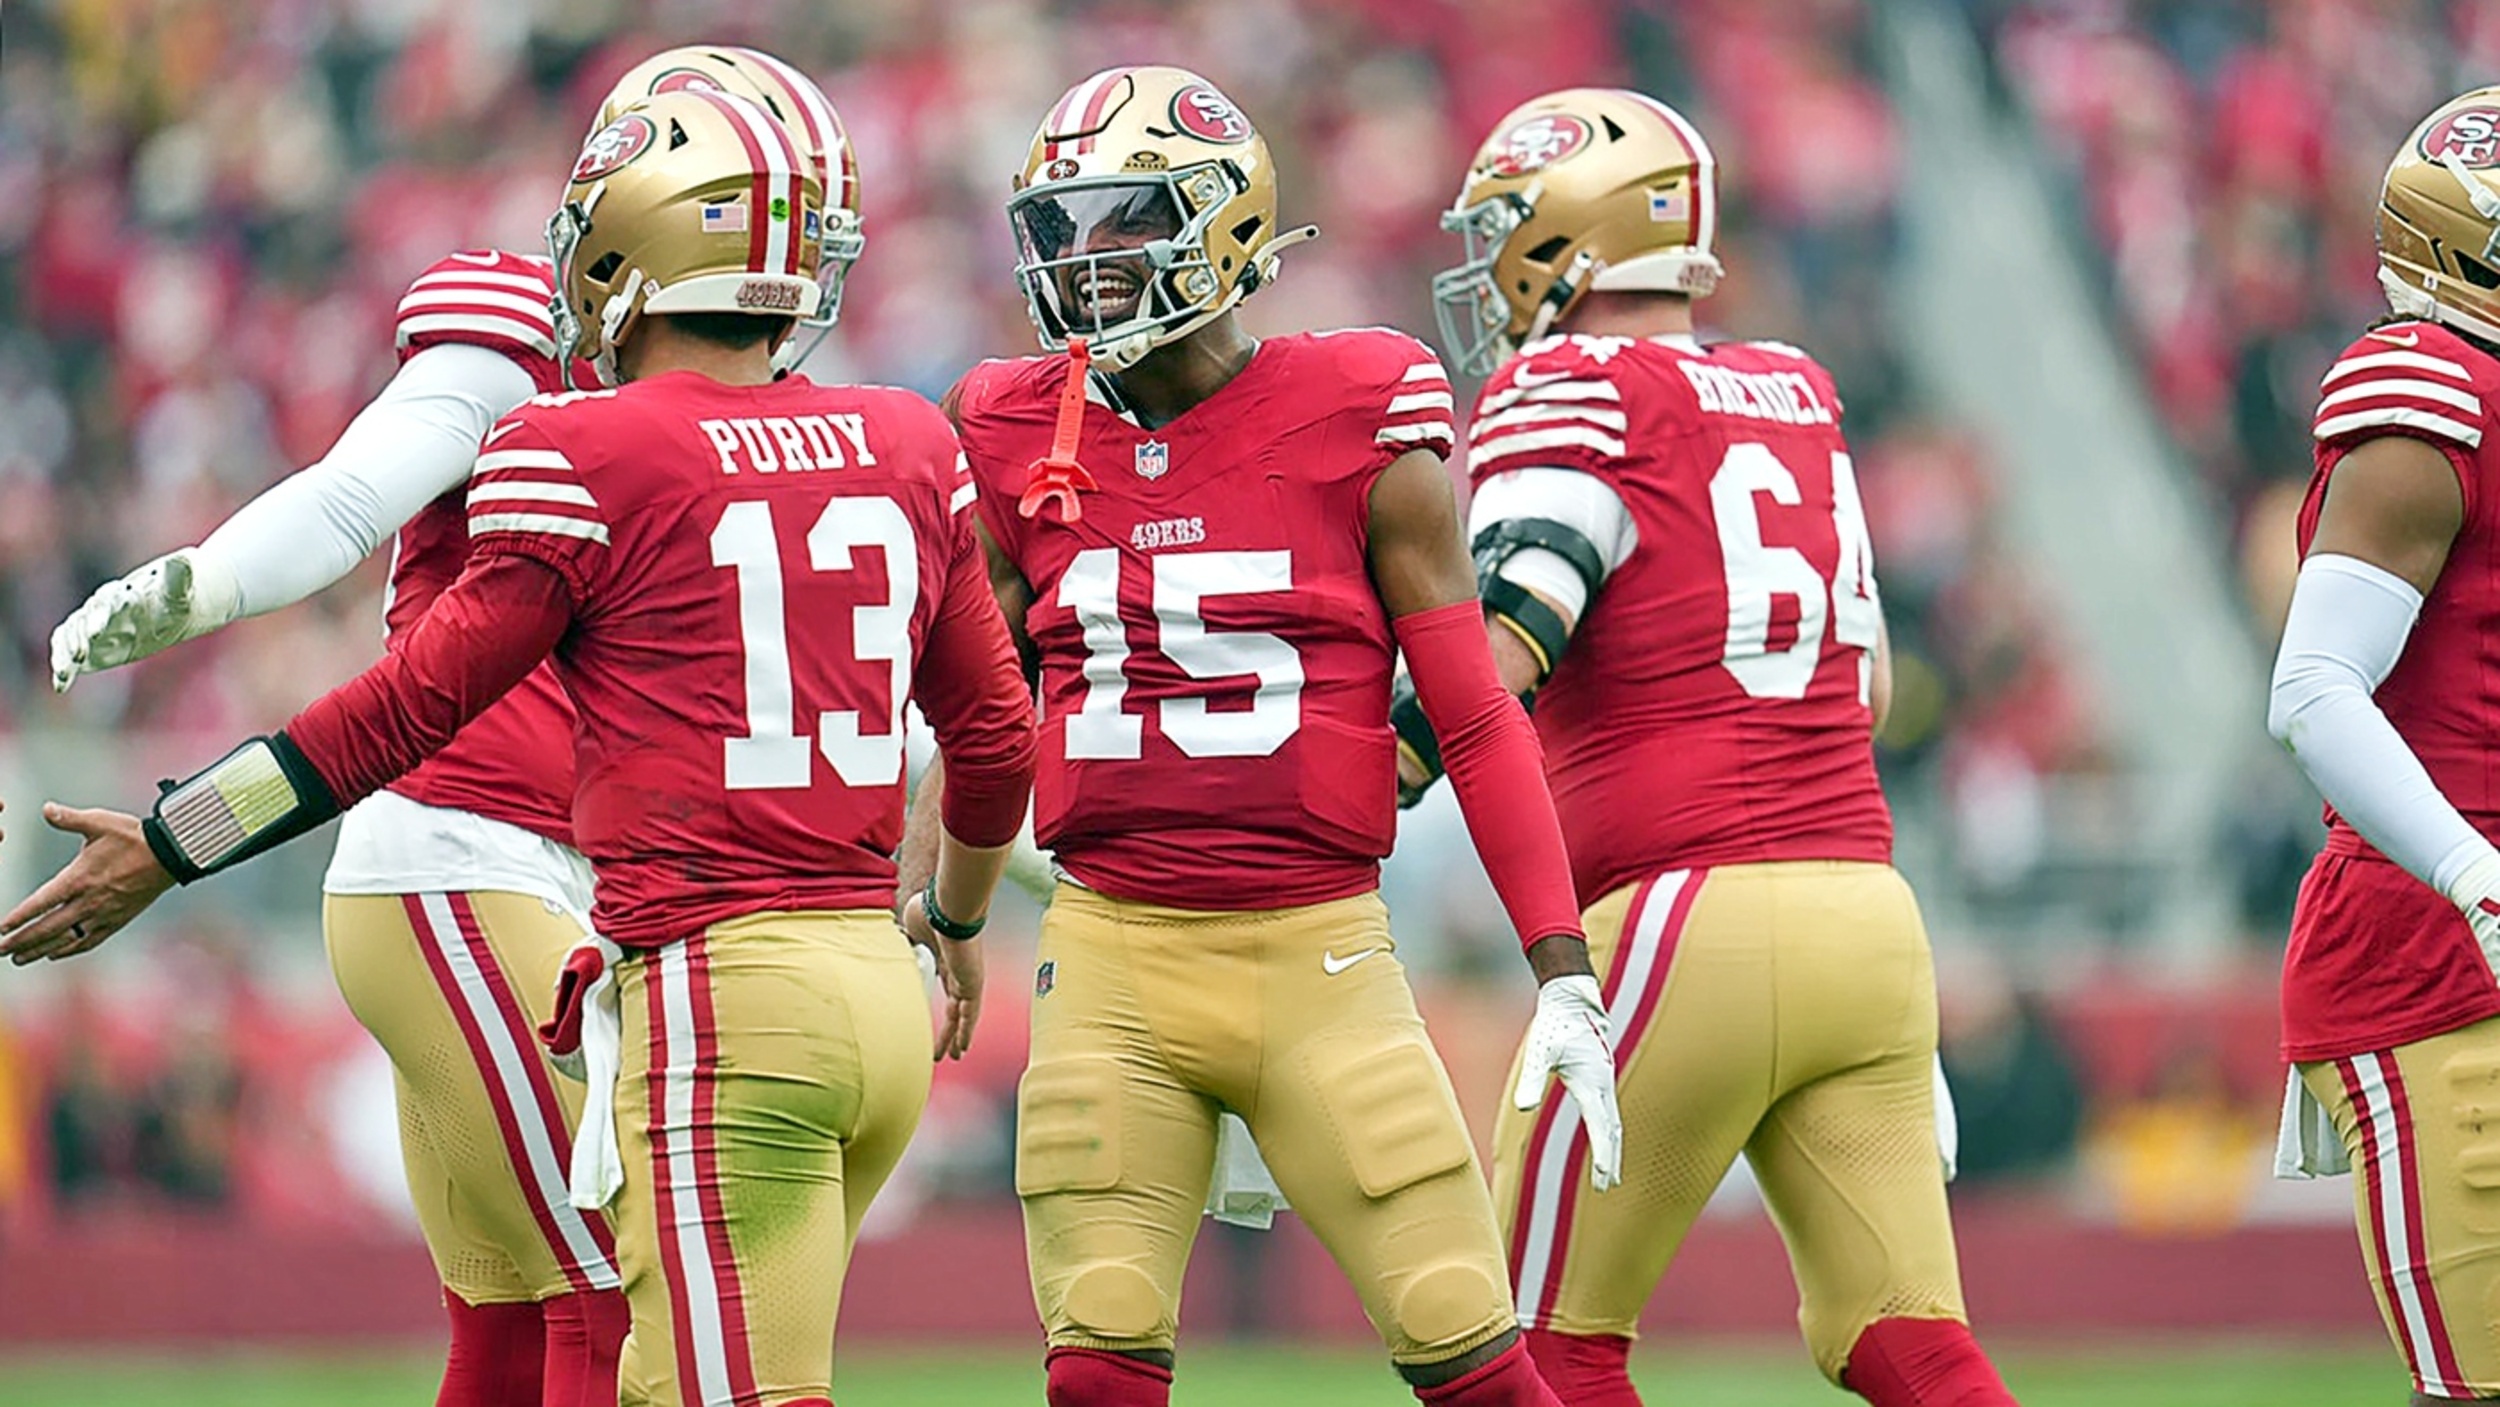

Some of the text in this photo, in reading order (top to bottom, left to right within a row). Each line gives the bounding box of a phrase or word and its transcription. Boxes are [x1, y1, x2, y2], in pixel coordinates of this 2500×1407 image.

[699, 412, 877, 475] PURDY
[1131, 517, 1206, 550] 49ERS
[709, 496, 919, 789] 13
[1056, 547, 1306, 760] 15
[1708, 442, 1877, 708] 64
